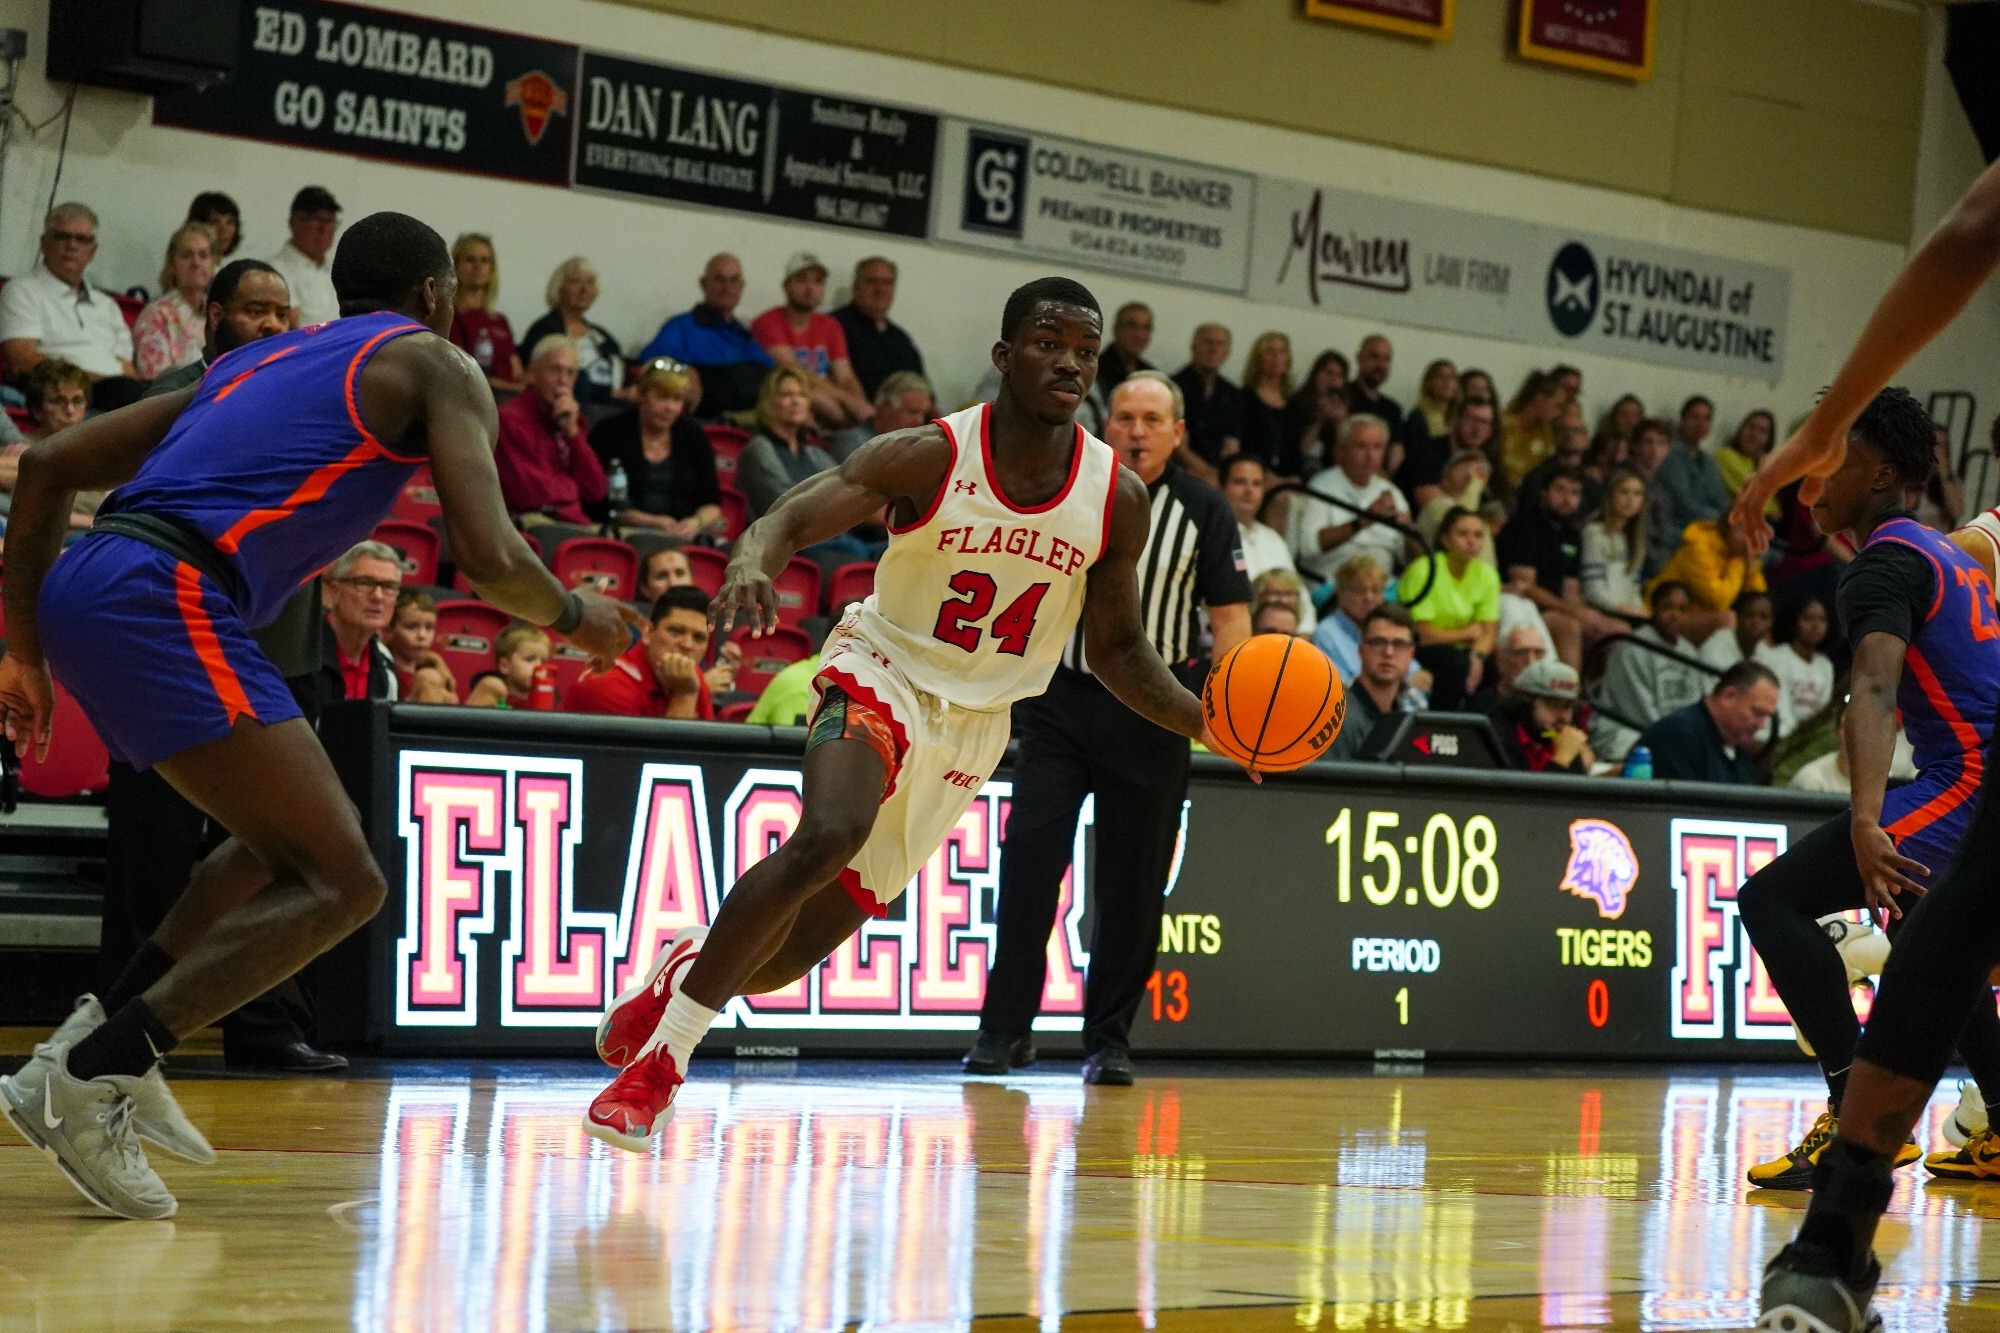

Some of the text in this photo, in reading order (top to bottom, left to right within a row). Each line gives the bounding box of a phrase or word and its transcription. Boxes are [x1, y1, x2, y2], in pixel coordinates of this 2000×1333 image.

[253, 7, 495, 88] ED LOMBARD
[274, 80, 467, 152] GO SAINTS
[587, 76, 759, 156] DAN LANG
[1033, 148, 1233, 210] COLDWELL BANKER
[1039, 196, 1224, 249] PREMIER PROPERTIES
[1424, 253, 1511, 296] LAW FIRM
[1604, 256, 1754, 316] HYUNDAI of
[932, 569, 1052, 657] 24
[1325, 807, 1500, 910] 15:08
[1157, 913, 1222, 954] NTS
[1352, 937, 1441, 973] PERIOD
[1556, 927, 1652, 968] TIGERS
[1146, 969, 1189, 1022] 13
[1394, 986, 1409, 1025] 1
[1587, 978, 1610, 1028] 0
